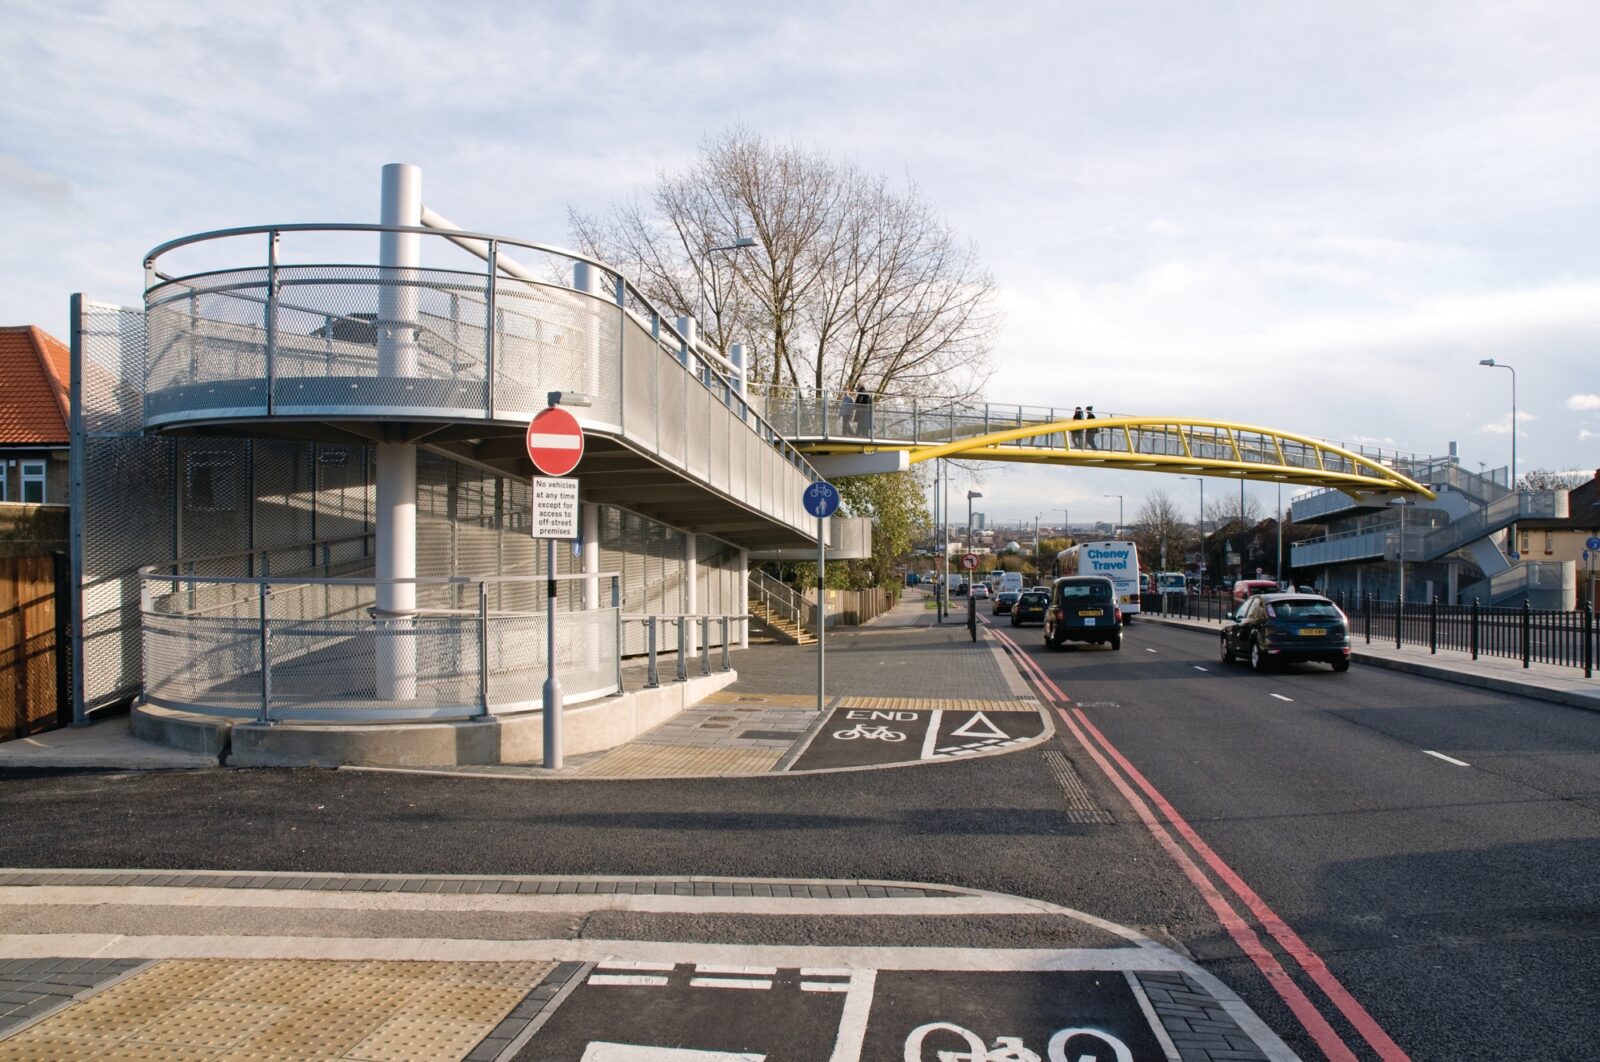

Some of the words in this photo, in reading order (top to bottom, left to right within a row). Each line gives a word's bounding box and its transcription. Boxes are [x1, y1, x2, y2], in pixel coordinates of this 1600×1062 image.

[548, 481, 576, 489] vehicles
[1088, 550, 1129, 560] Cheney
[1092, 560, 1127, 570] Travel
[846, 710, 918, 721] END
